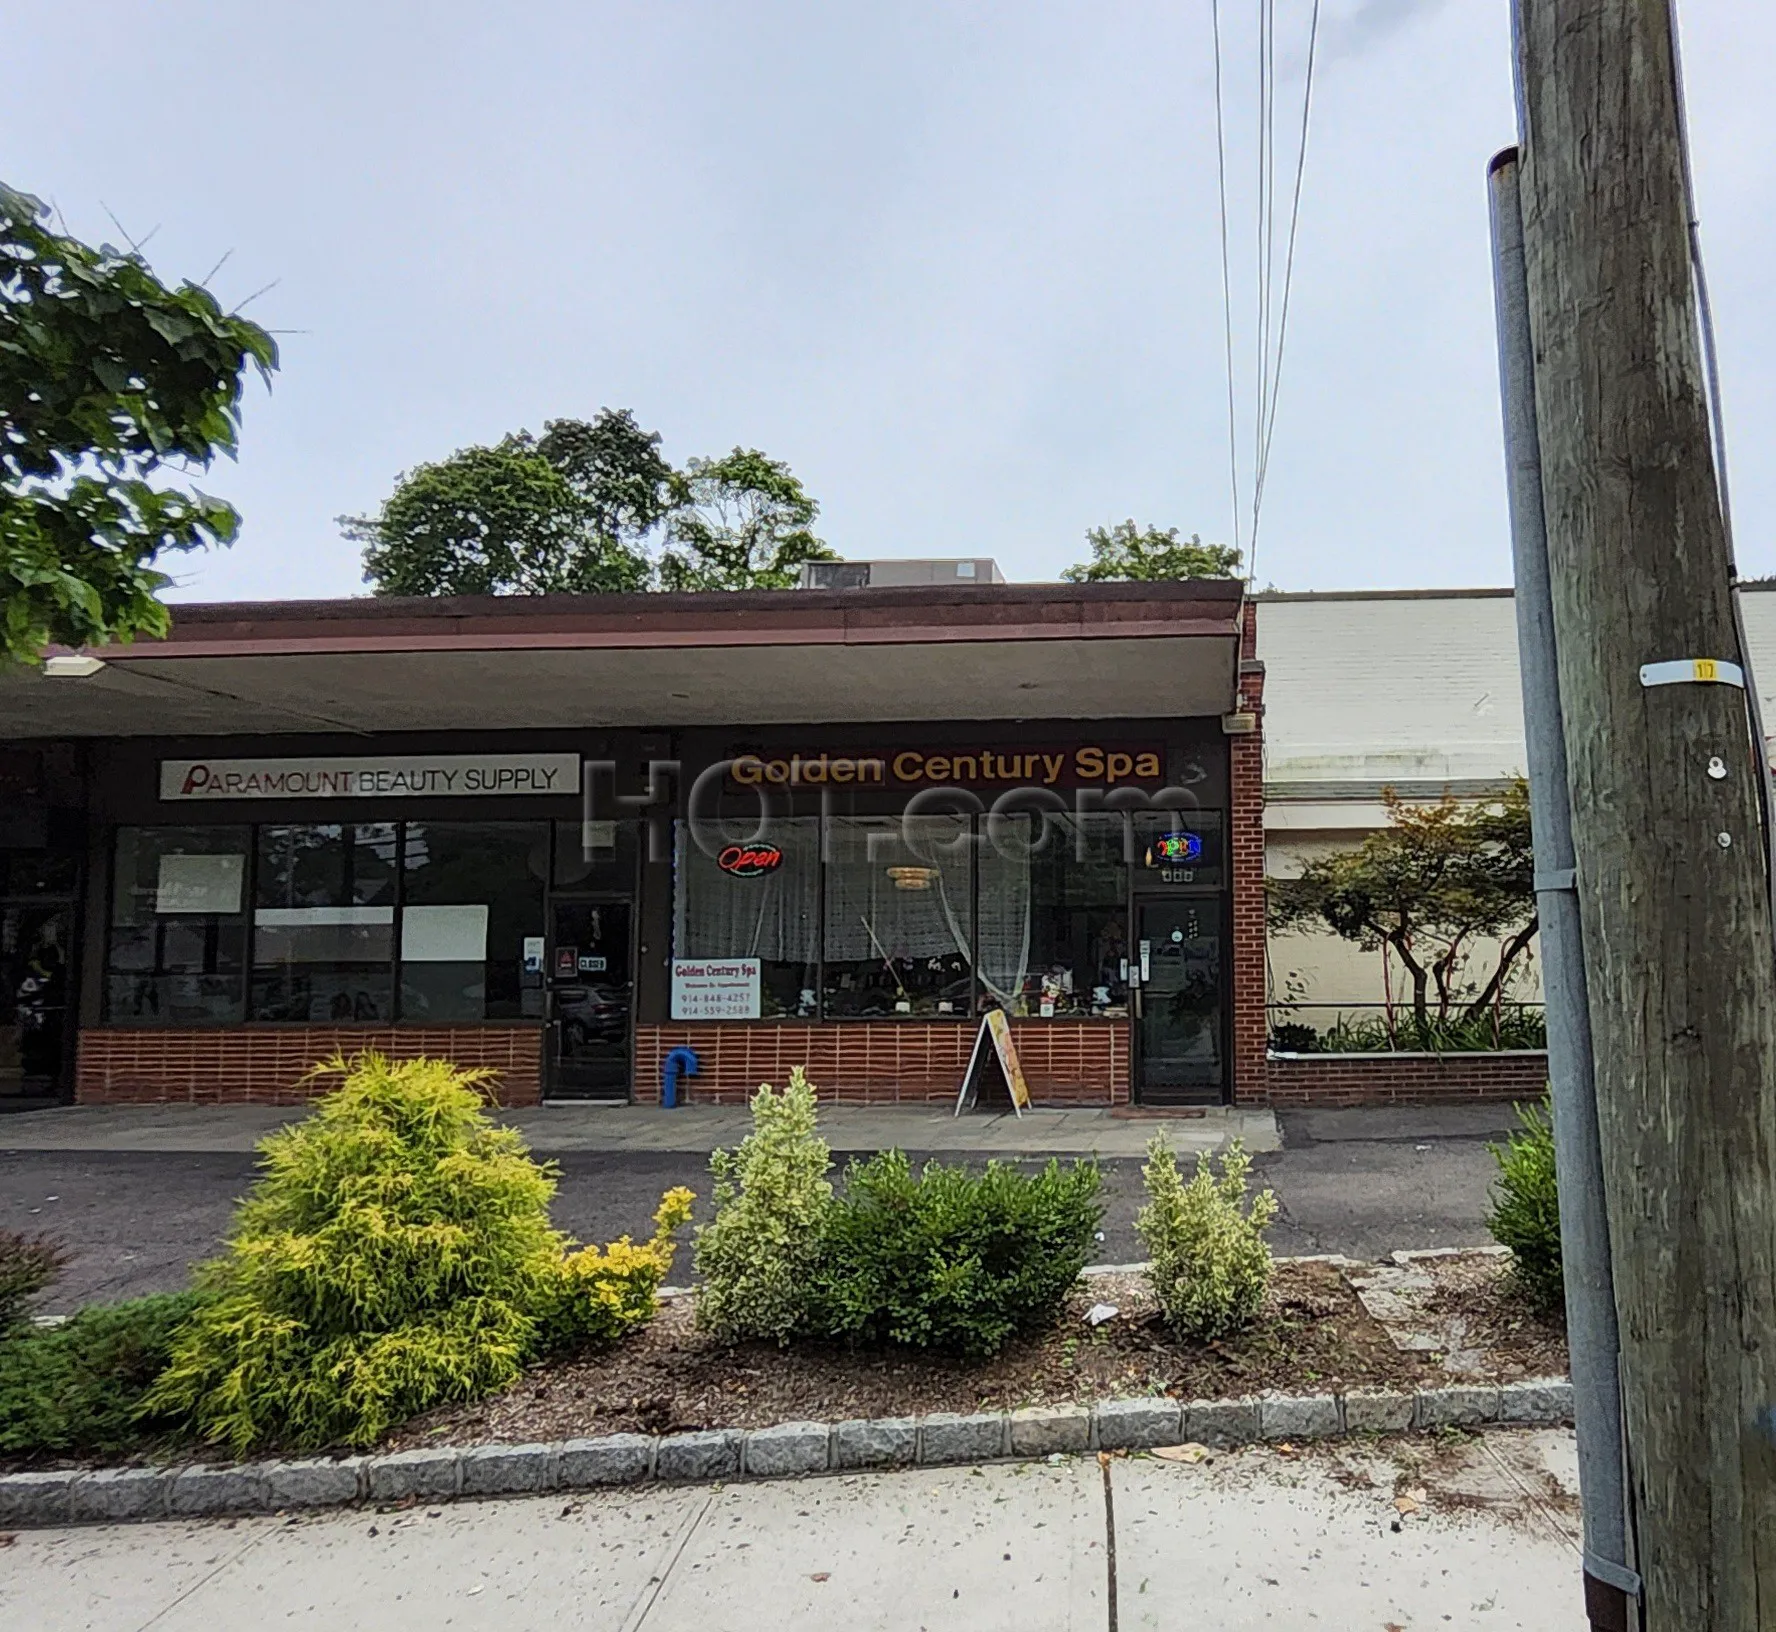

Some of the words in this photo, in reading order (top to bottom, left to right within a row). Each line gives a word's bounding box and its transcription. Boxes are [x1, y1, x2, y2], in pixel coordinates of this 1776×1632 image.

[1697, 663, 1714, 678] 17
[731, 753, 883, 784] Golden
[893, 750, 1065, 784] Century
[1075, 746, 1160, 779] Spa
[181, 764, 353, 795] PARAMOUNT
[359, 769, 458, 793] BEAUTY
[464, 767, 559, 790] SUPPLY
[718, 846, 780, 871] Open
[675, 964, 705, 977] Golden
[706, 963, 740, 978] Century
[741, 963, 757, 978] Spa
